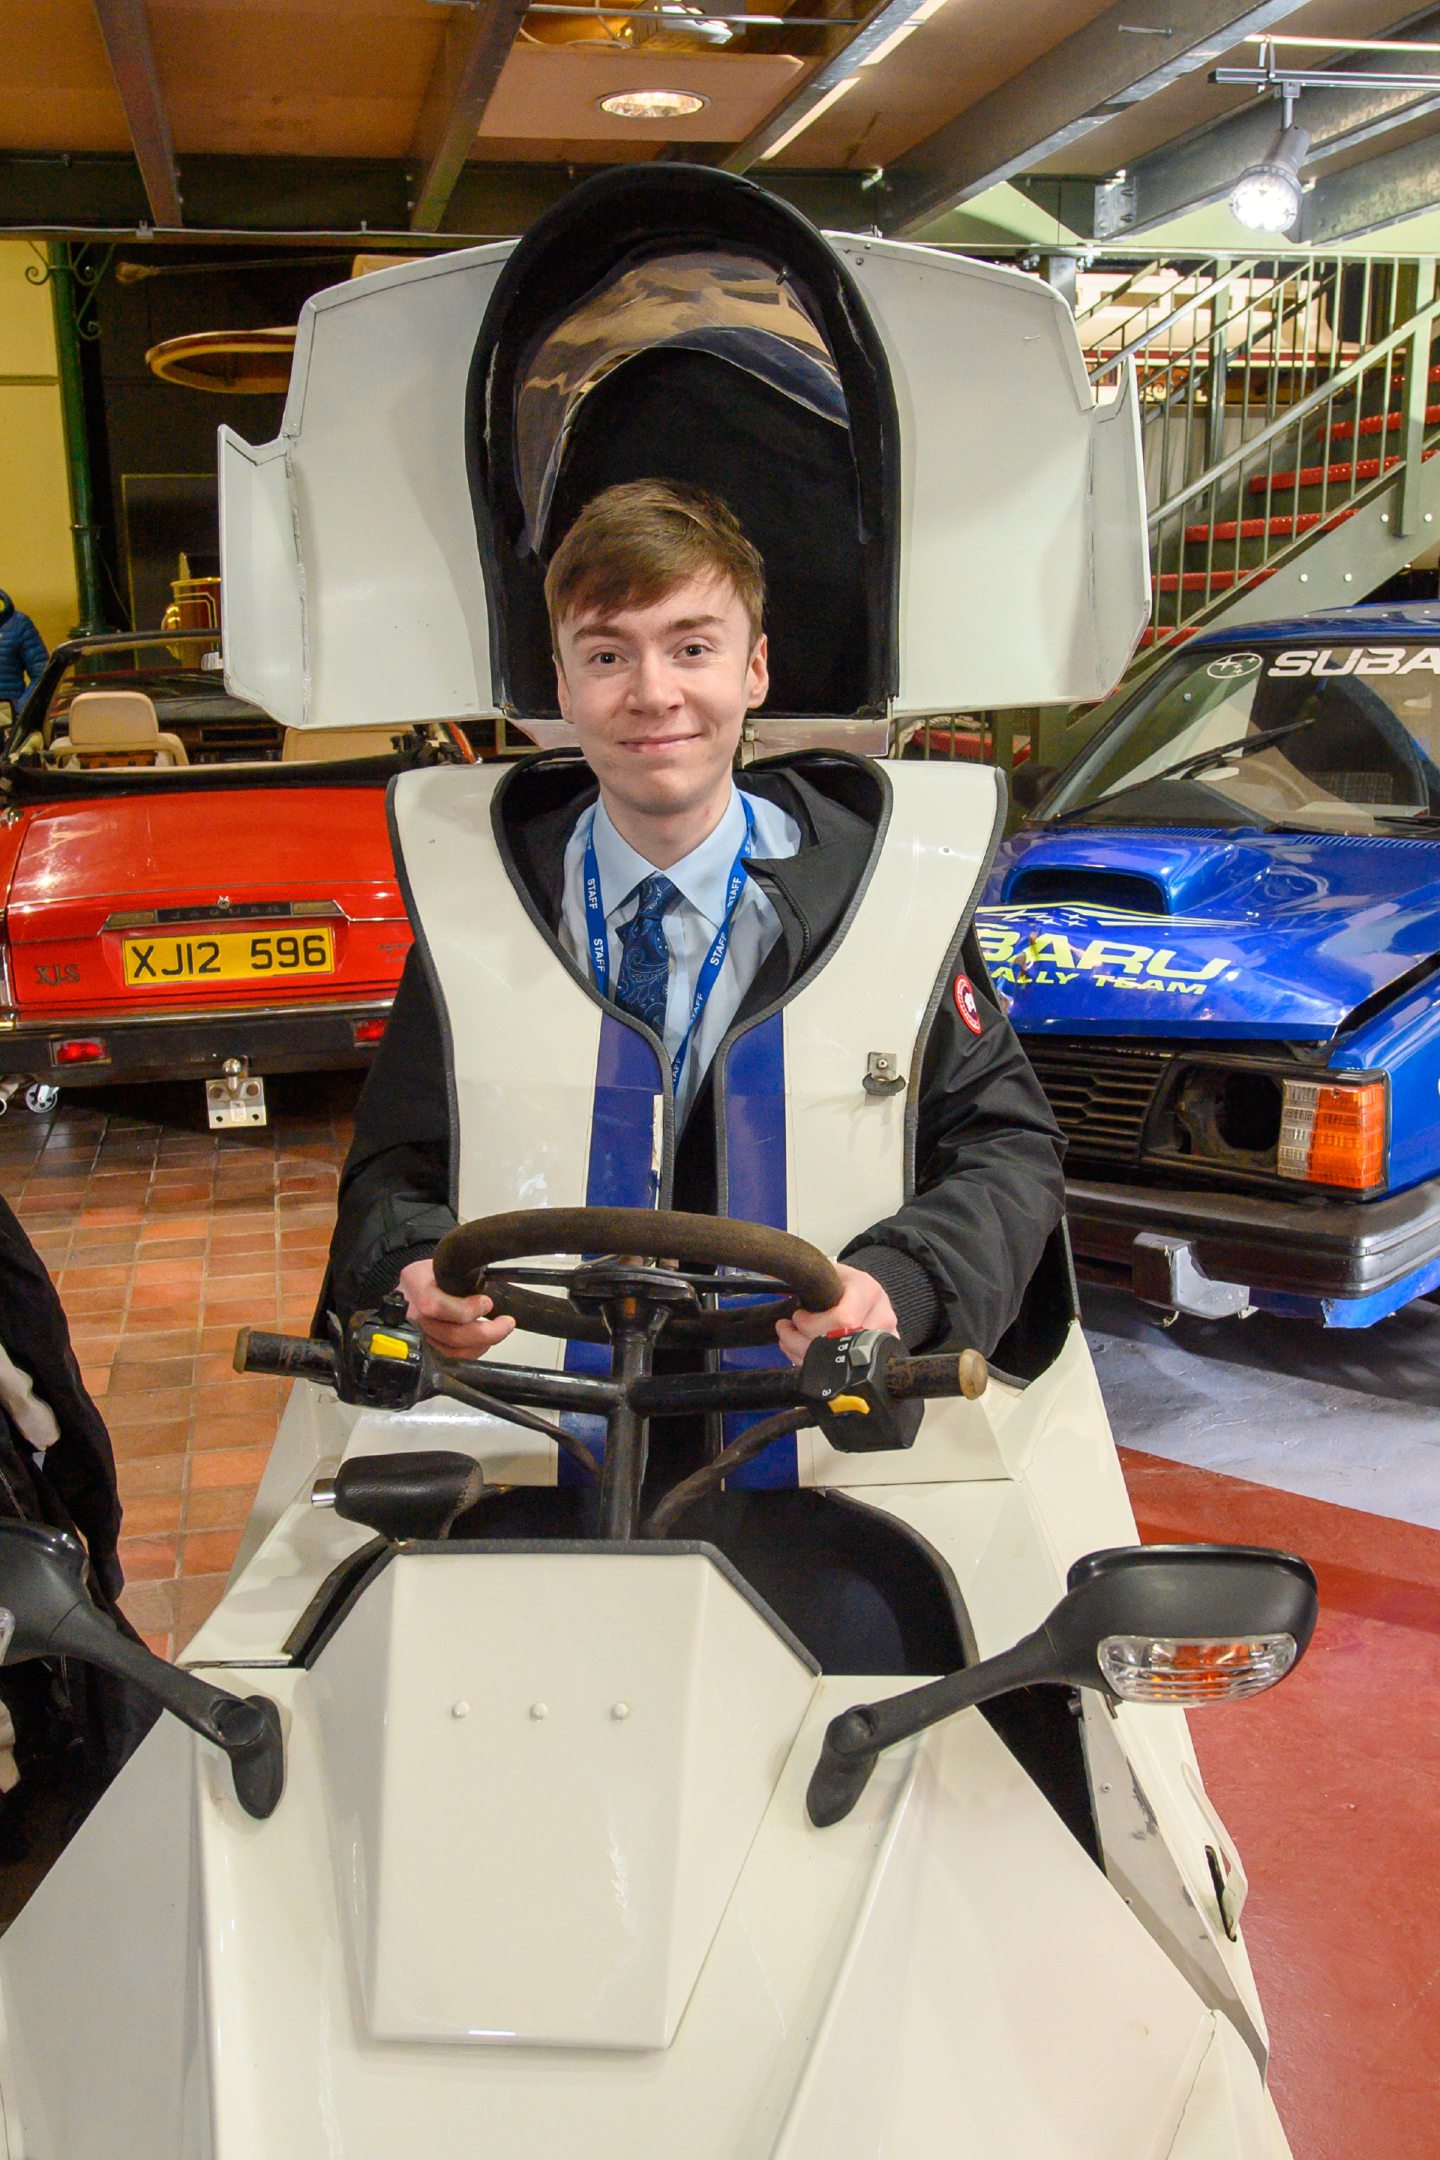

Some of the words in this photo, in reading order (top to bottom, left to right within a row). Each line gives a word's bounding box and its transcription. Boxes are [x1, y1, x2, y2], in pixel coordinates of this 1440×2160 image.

[1267, 647, 1440, 677] SUBA
[587, 878, 598, 910] STAFF
[131, 941, 221, 978] XJ12
[250, 934, 327, 970] 596
[593, 937, 606, 973] STAFF
[709, 931, 727, 967] STAFF
[976, 927, 1231, 980] BARU
[1092, 974, 1208, 995] TEAM
